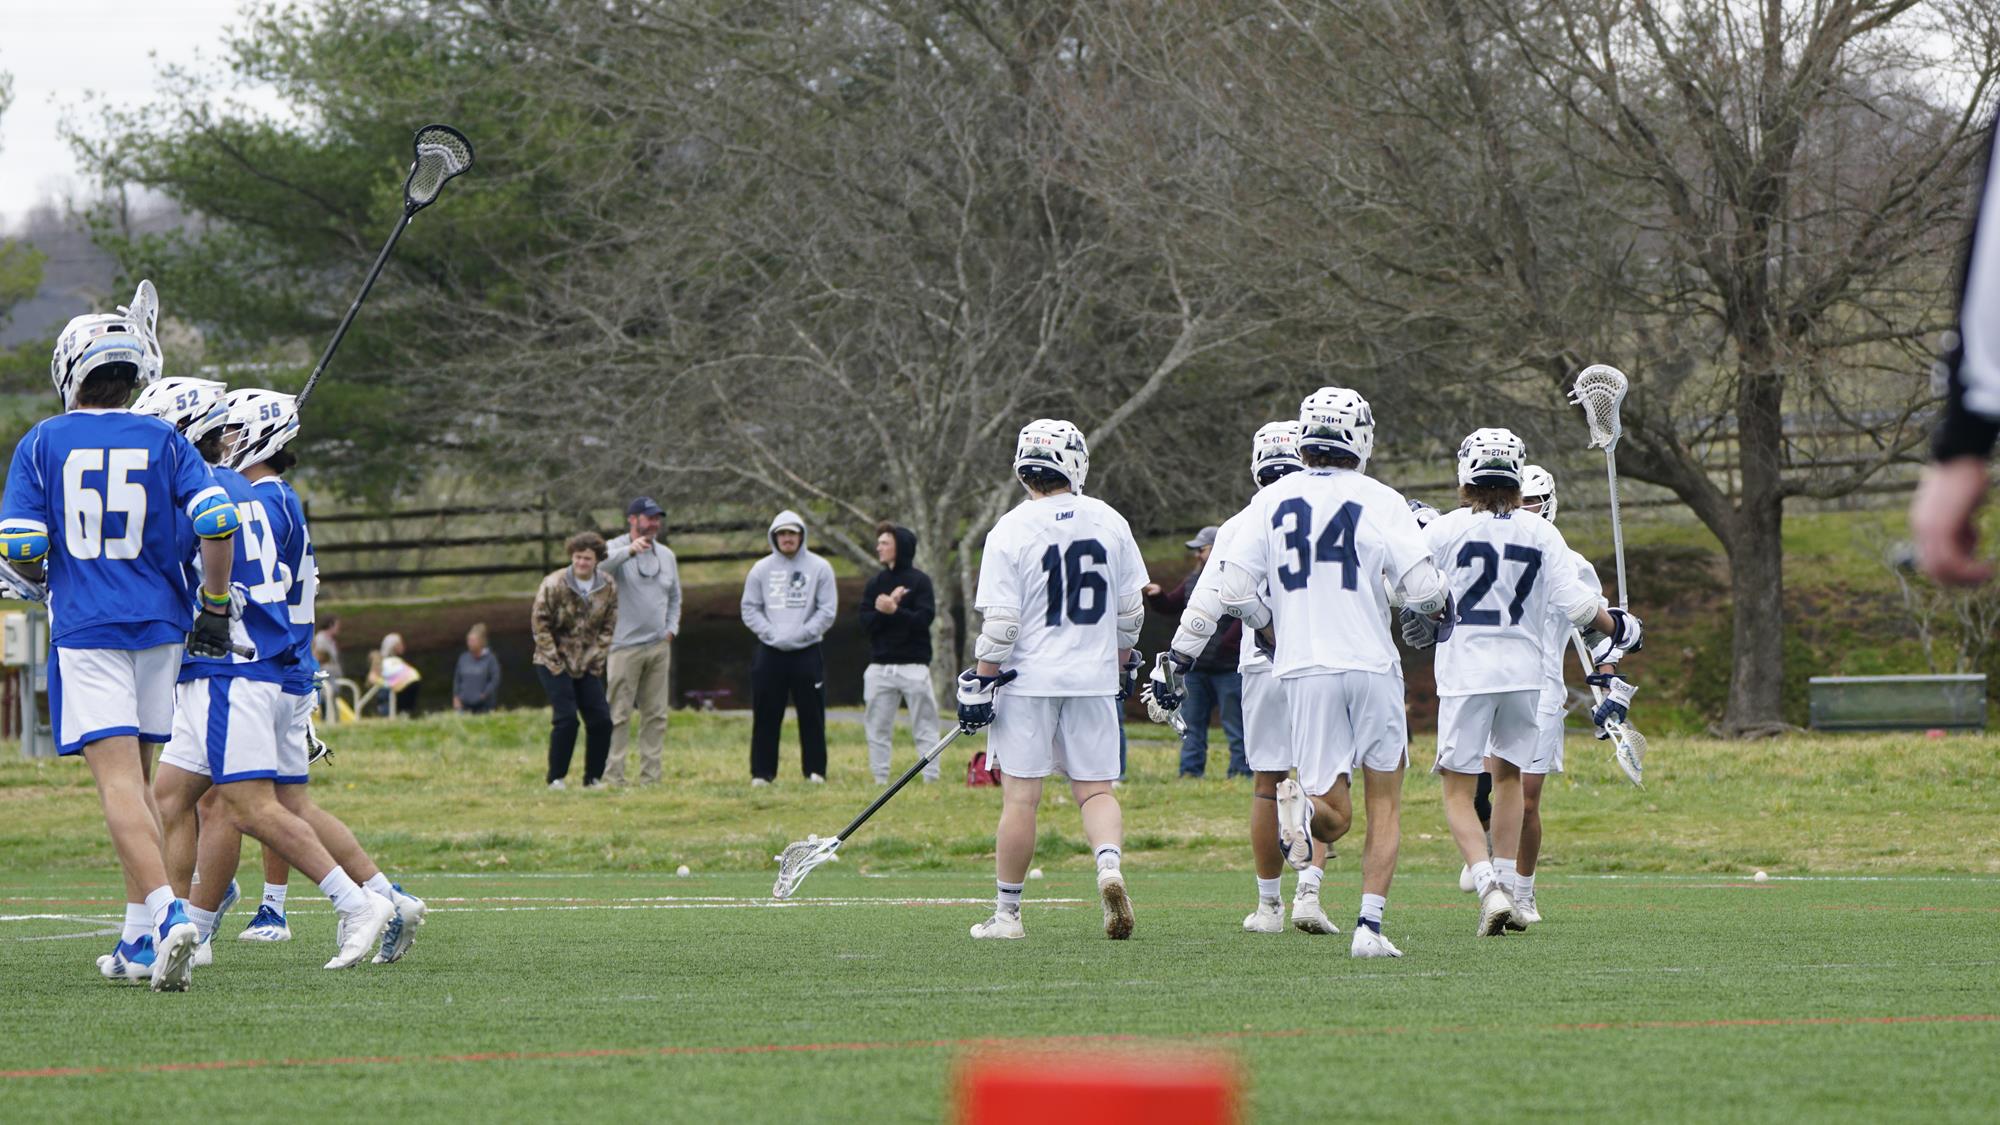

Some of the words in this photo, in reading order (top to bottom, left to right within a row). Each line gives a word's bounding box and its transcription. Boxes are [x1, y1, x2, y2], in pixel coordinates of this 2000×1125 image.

[176, 390, 199, 411] 52
[260, 402, 280, 420] 56
[1321, 416, 1331, 424] 34
[1272, 436, 1280, 444] 47
[1491, 448, 1500, 457] 27
[63, 448, 149, 560] 65
[1055, 511, 1074, 521] LMU
[1271, 496, 1363, 592] 34
[1041, 538, 1107, 627] 16
[1456, 541, 1542, 626] 27
